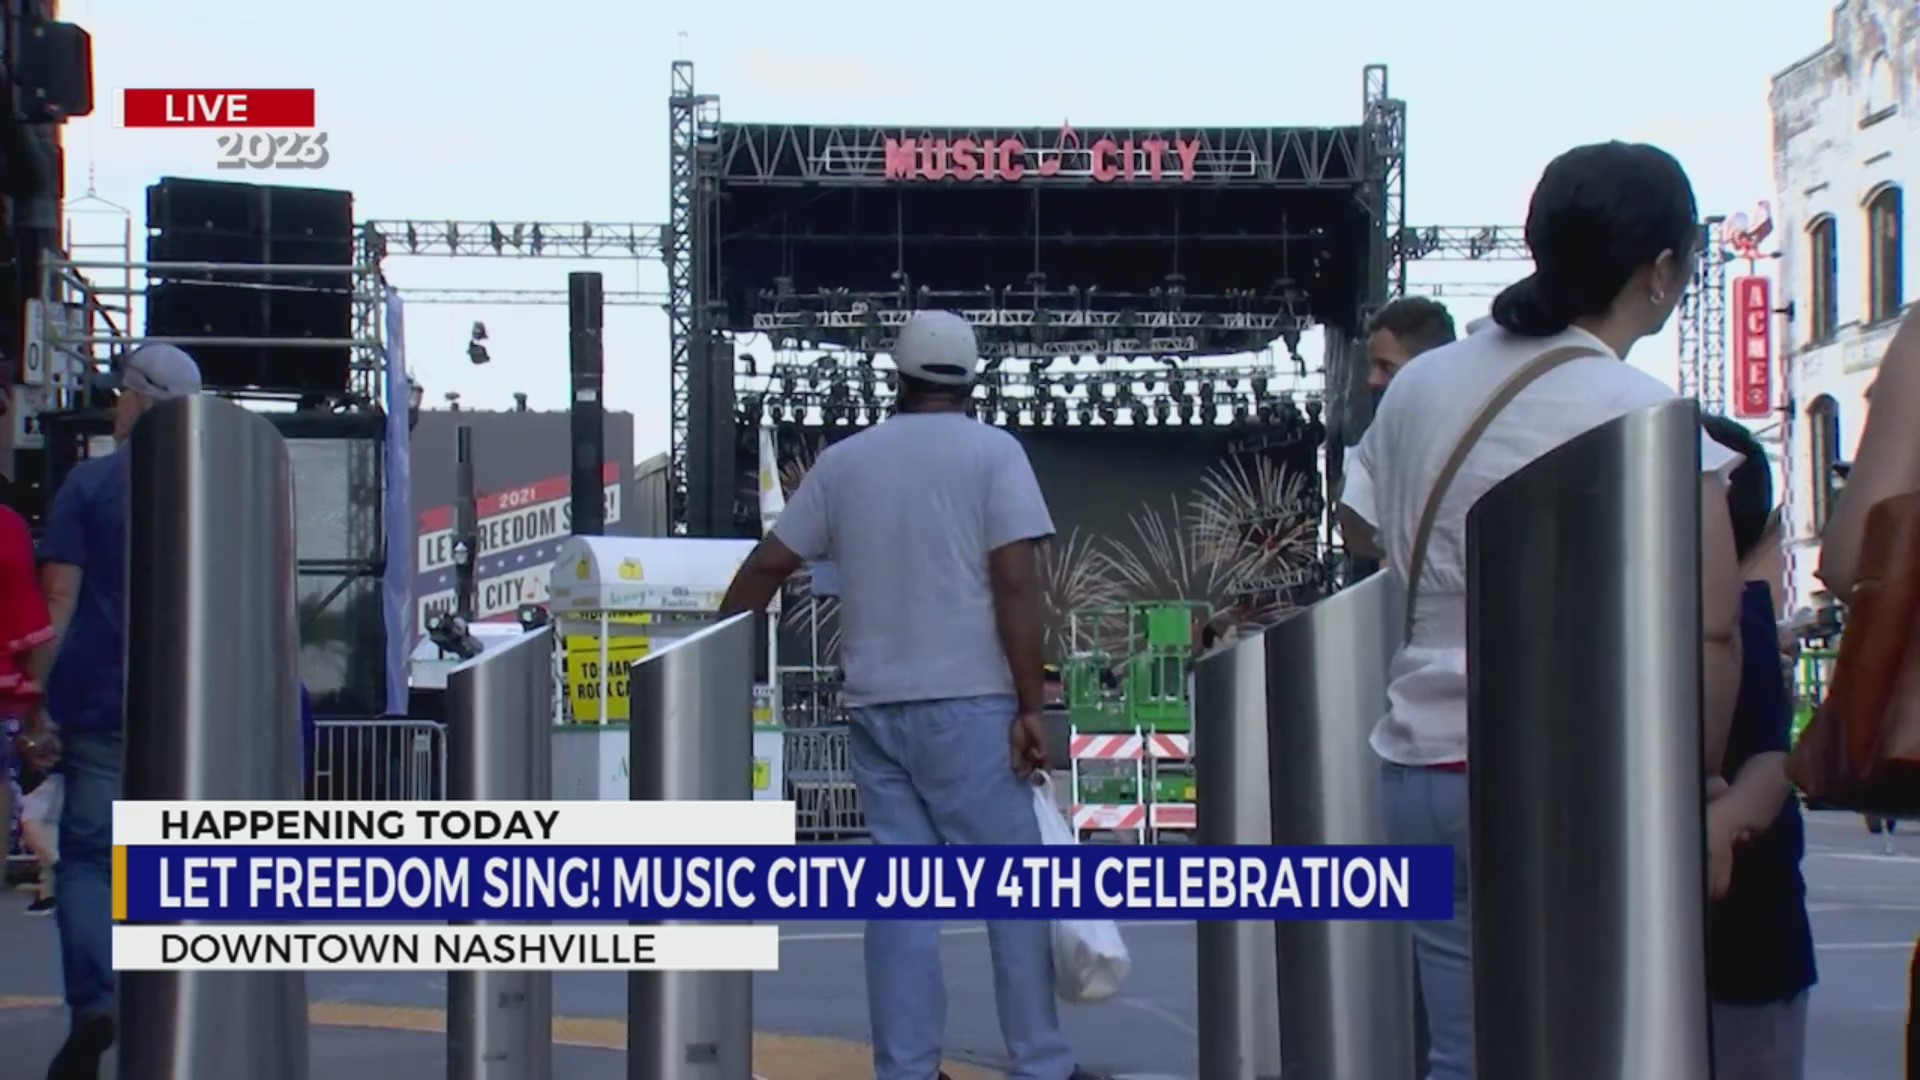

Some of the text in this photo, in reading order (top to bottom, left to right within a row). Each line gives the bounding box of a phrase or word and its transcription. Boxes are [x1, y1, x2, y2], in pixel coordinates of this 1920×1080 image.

[884, 138, 1201, 182] MUSIC CITY
[1747, 284, 1767, 386] ACME
[499, 487, 536, 509] 2021
[426, 535, 450, 566] LE
[479, 506, 557, 552] REEDOM
[485, 577, 525, 611] CITY
[580, 659, 631, 679] TO HAR
